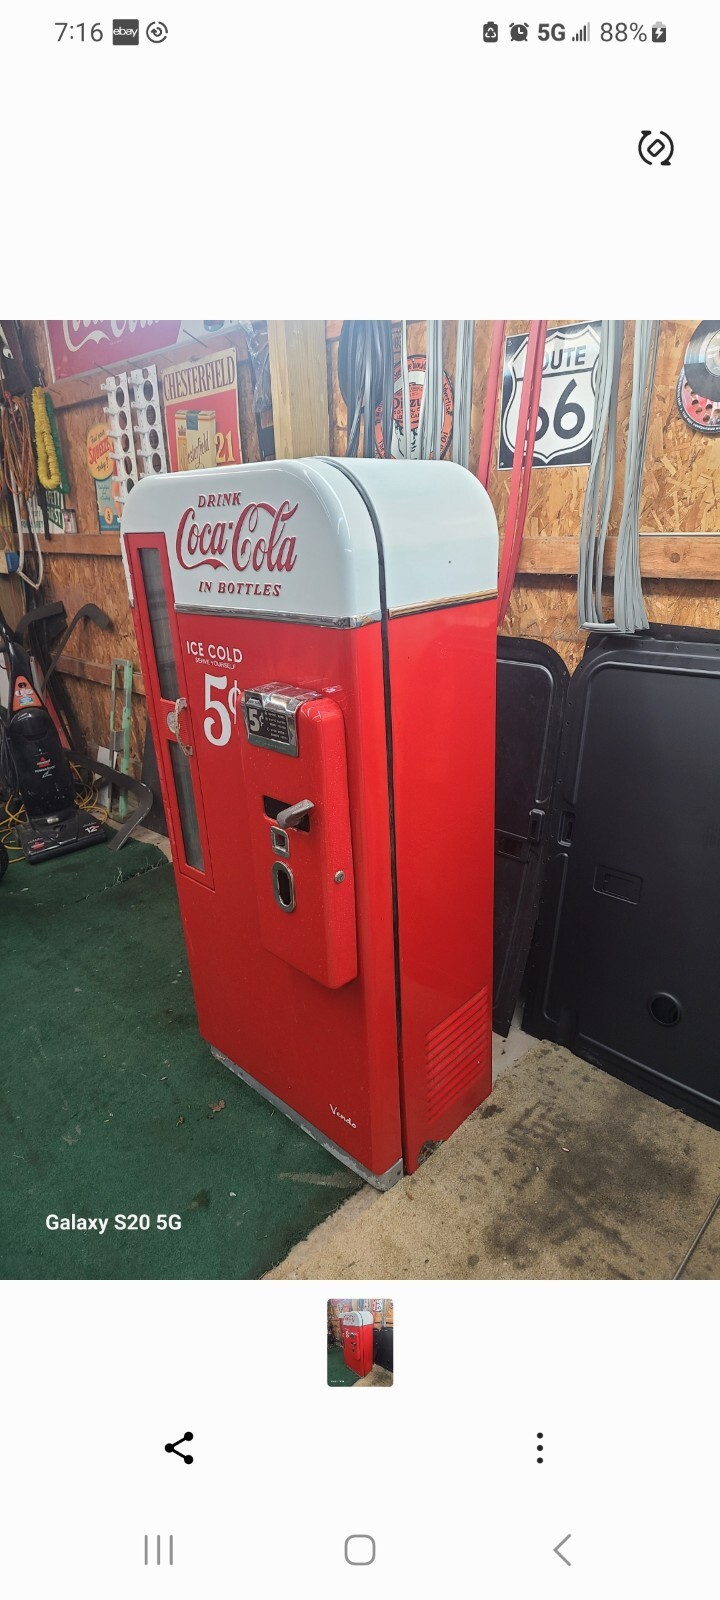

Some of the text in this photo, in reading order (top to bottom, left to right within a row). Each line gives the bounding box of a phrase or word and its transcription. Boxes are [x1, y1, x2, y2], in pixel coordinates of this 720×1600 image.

[163, 355, 236, 402] CHESTERFIELD
[214, 430, 235, 463] 21
[198, 492, 242, 508] DRINK
[175, 500, 299, 572] Coca-Cola
[199, 581, 282, 597] IN BOTTLES
[186, 640, 243, 663] ICE COLD
[195, 656, 211, 666] SERVE
[329, 1103, 357, 1129] Vendo
